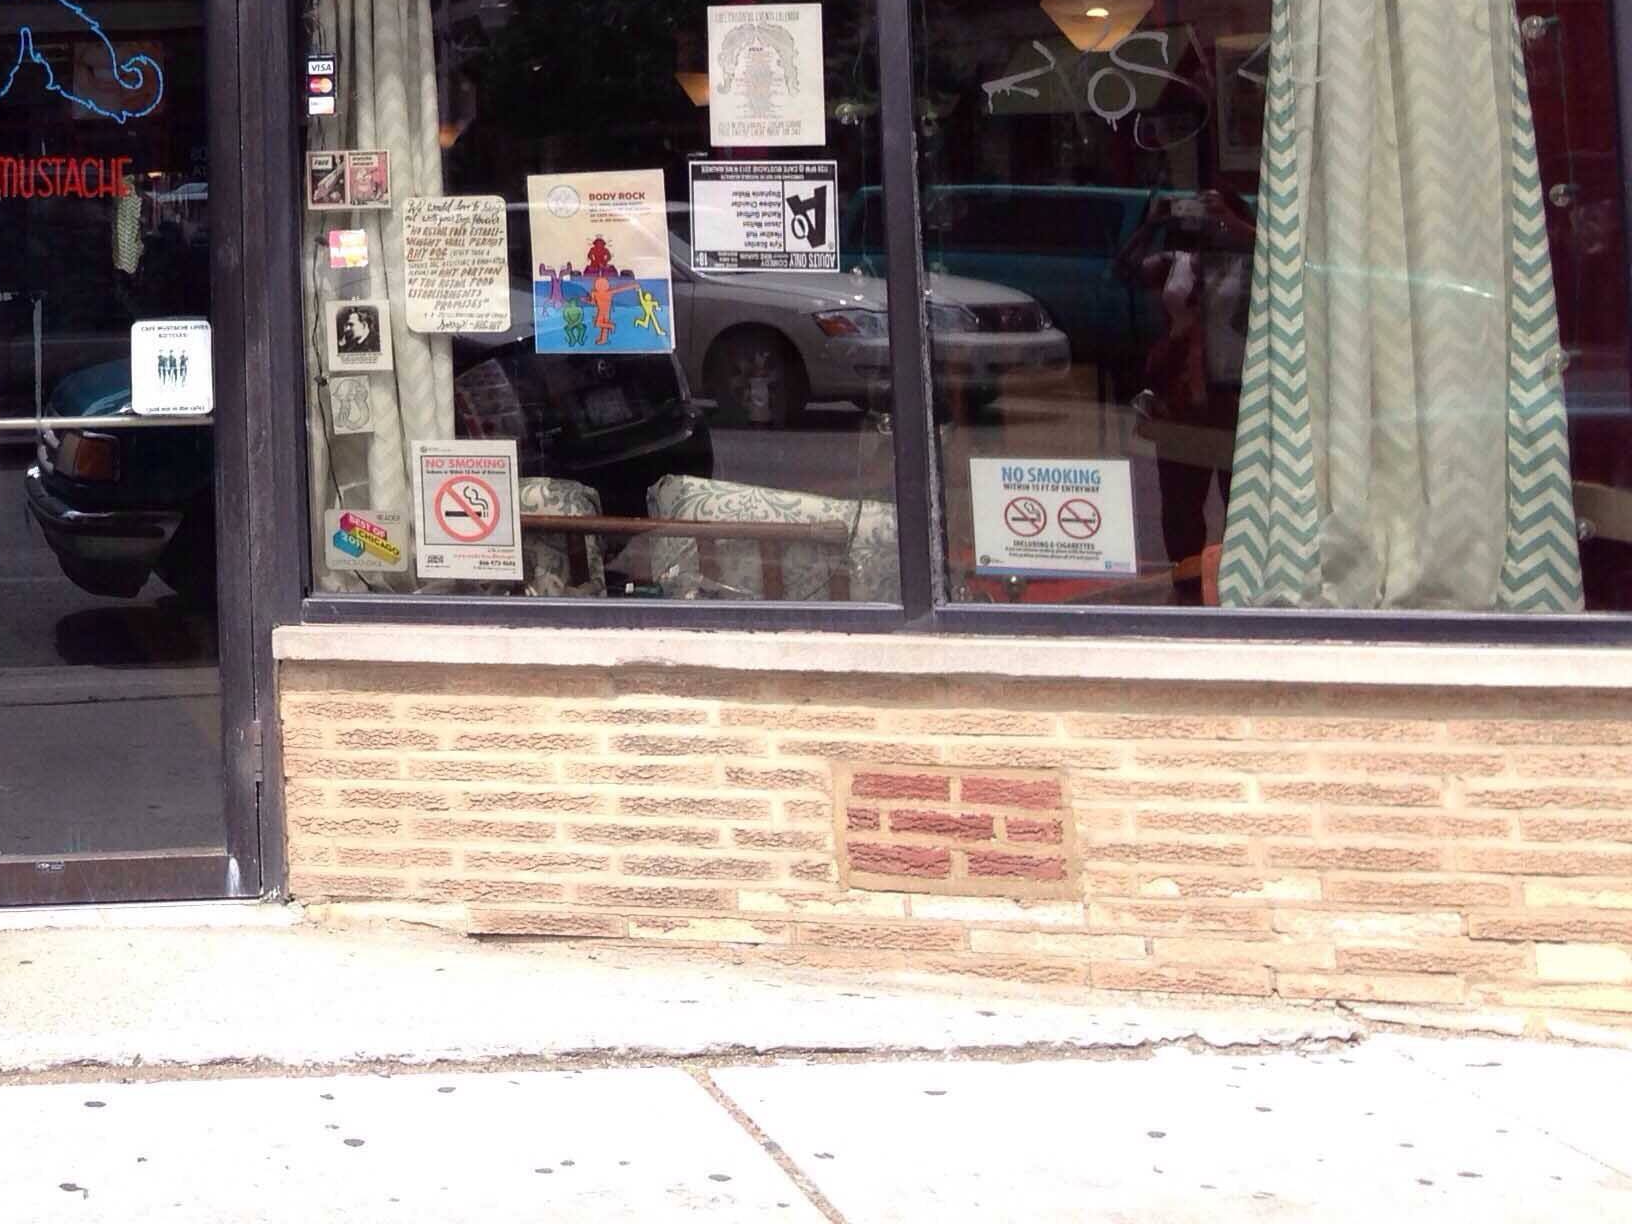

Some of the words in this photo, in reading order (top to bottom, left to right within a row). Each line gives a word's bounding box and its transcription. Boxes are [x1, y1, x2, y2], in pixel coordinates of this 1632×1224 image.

[311, 64, 332, 72] VISA
[589, 192, 616, 201] BODY
[619, 191, 645, 200] ROCK
[789, 253, 807, 268] ONLY
[808, 253, 836, 268] ADULTS
[425, 459, 444, 468] NO
[448, 459, 506, 468] SMOKING
[1001, 466, 1024, 482] NO
[1028, 467, 1101, 484] SMOKING
[373, 526, 386, 537] OF
[341, 533, 365, 550] 2011
[358, 530, 400, 556] CHICAGO
